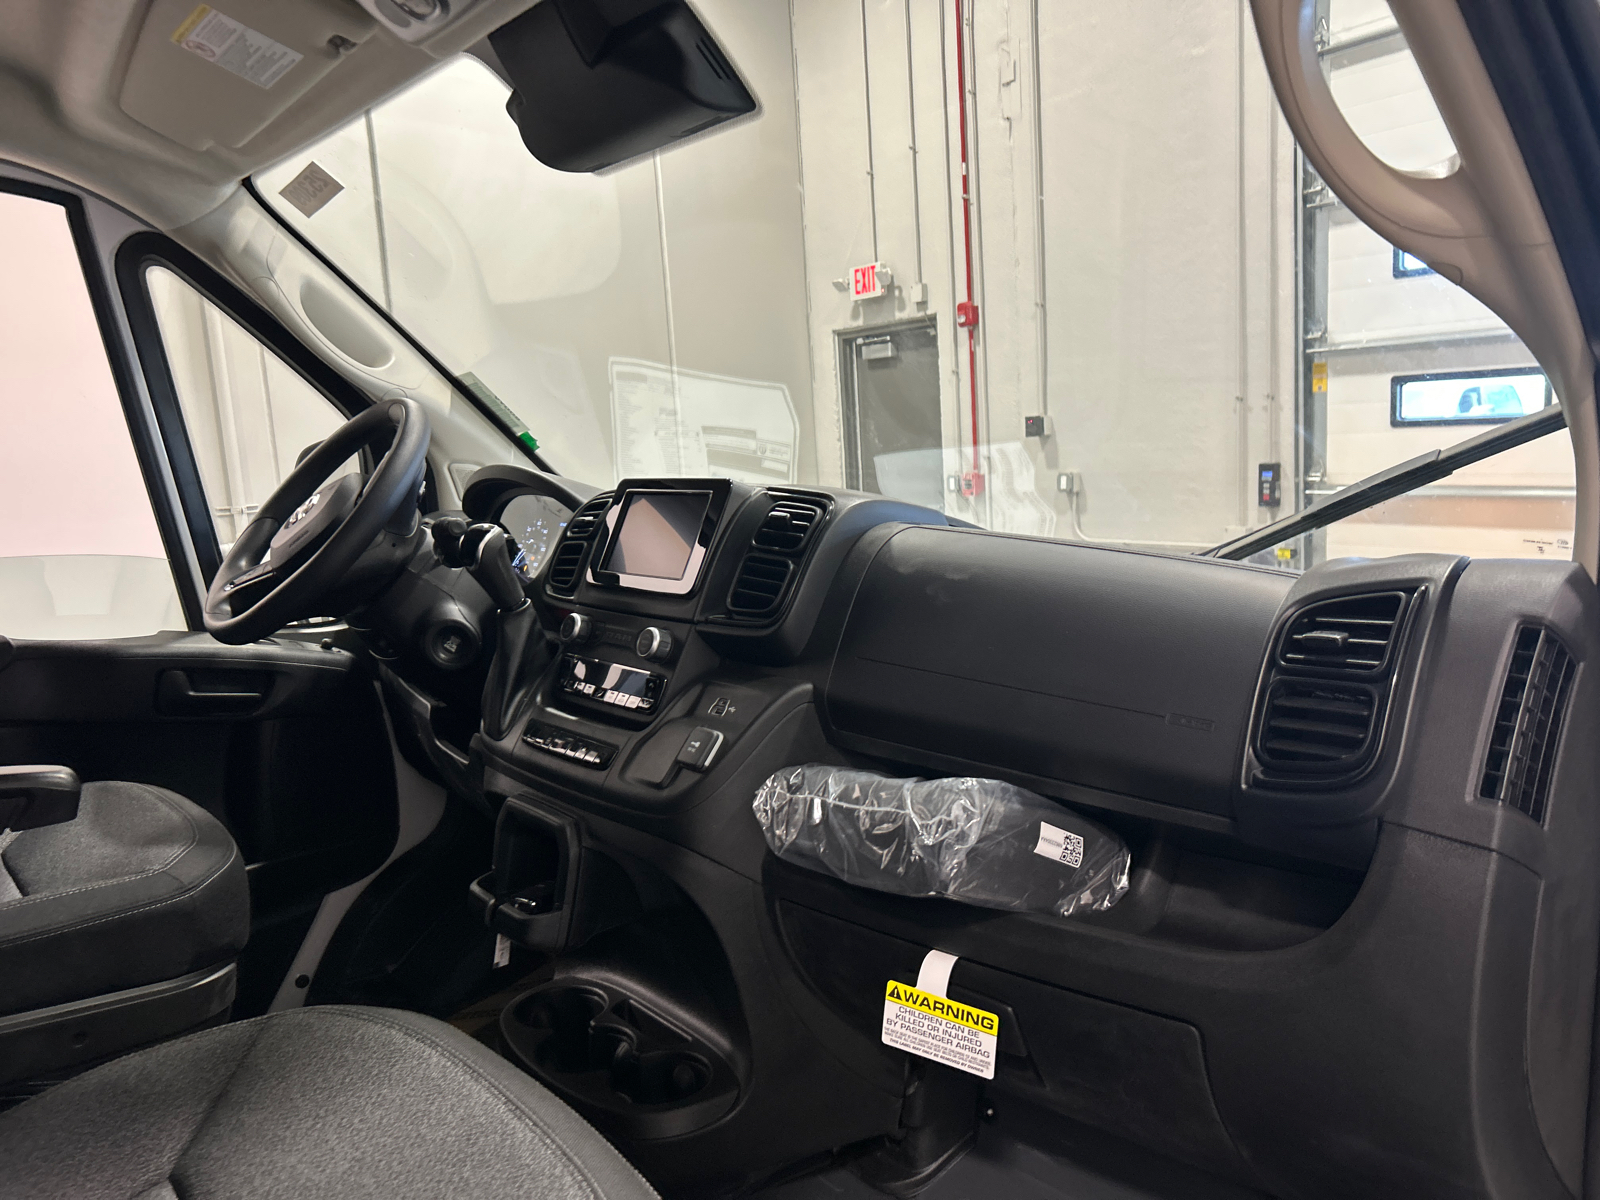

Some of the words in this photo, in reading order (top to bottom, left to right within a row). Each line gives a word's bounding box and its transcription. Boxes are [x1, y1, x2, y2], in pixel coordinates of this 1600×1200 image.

[854, 265, 876, 295] EXIT
[898, 1006, 943, 1027] CHILDREN
[945, 1021, 965, 1034] CAN
[968, 1028, 980, 1039] BE
[904, 989, 995, 1031] WARNING
[886, 1017, 899, 1028] BY
[900, 1022, 953, 1047] PASSENGER
[955, 1042, 991, 1060] AIRBAG
[895, 1012, 925, 1029] KILLED
[926, 1024, 940, 1034] OR
[942, 1028, 983, 1048] INJURED
